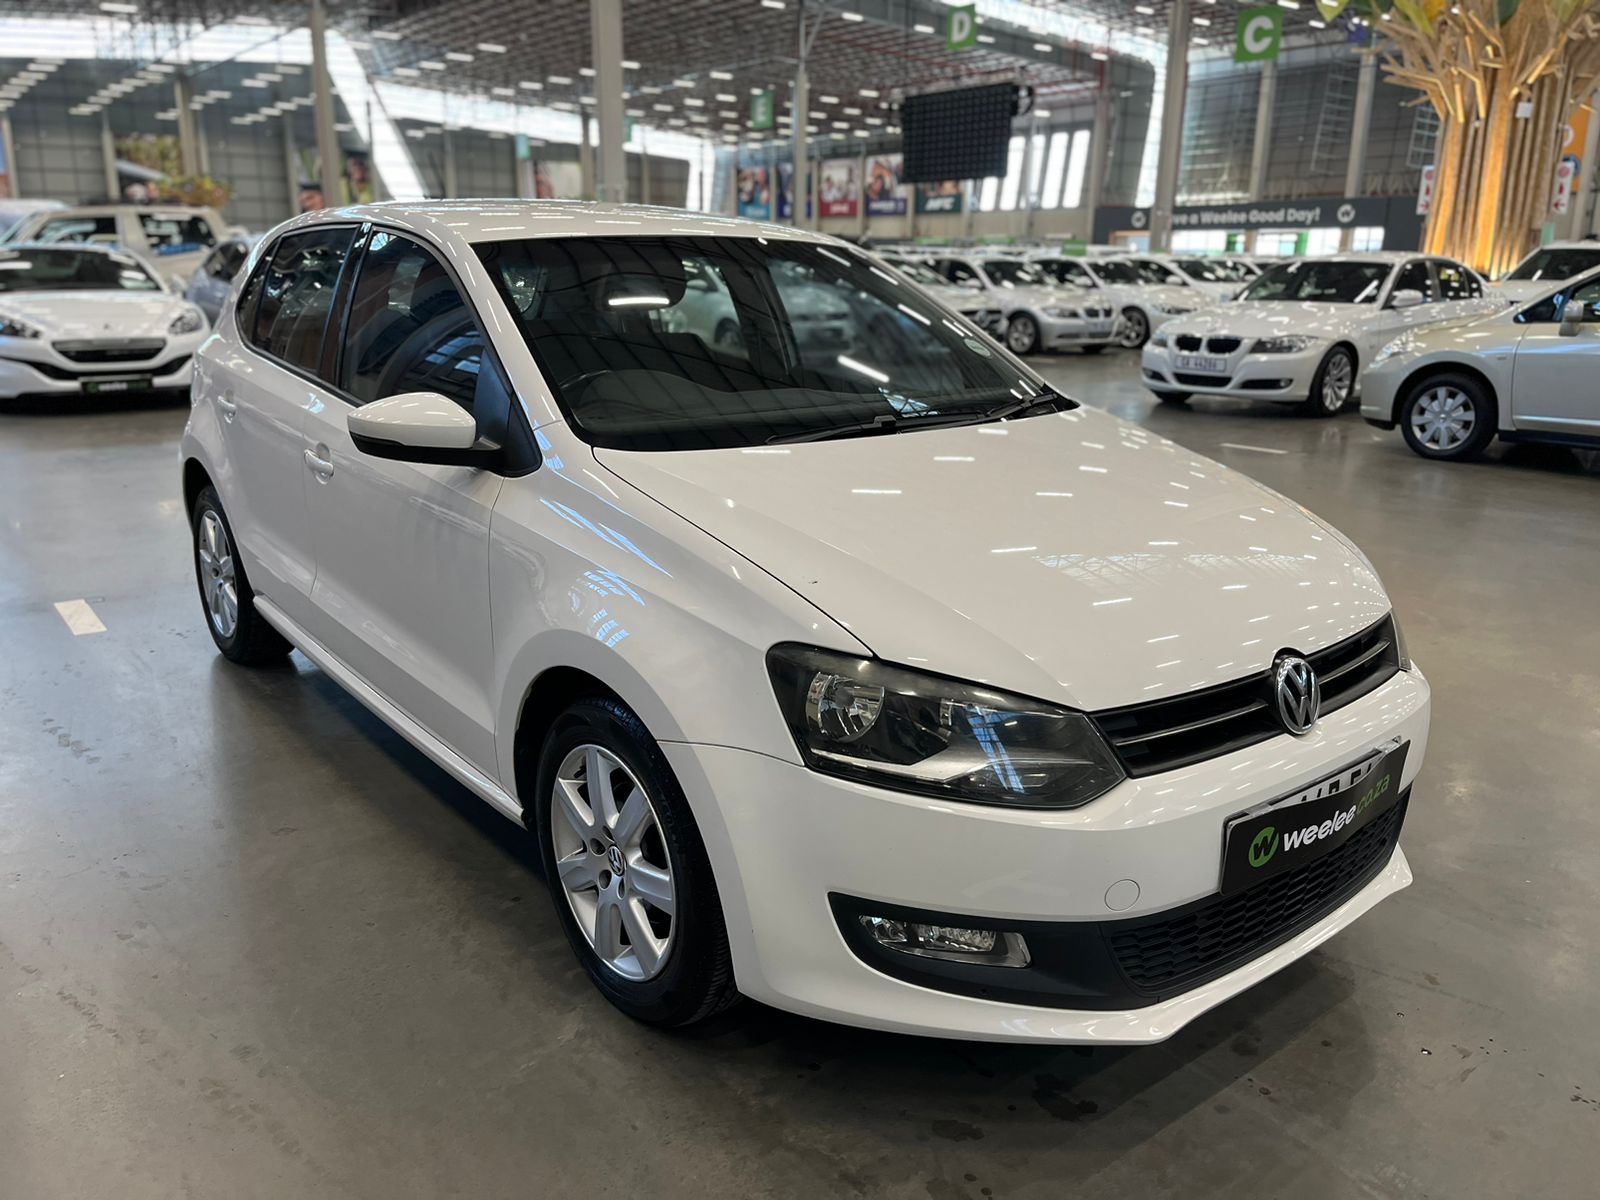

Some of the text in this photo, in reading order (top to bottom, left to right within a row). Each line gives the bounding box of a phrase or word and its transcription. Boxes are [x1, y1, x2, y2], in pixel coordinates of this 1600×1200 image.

[952, 11, 971, 43] D
[1244, 16, 1274, 54] C
[1249, 209, 1285, 223] Good
[1286, 206, 1321, 226] Day!
